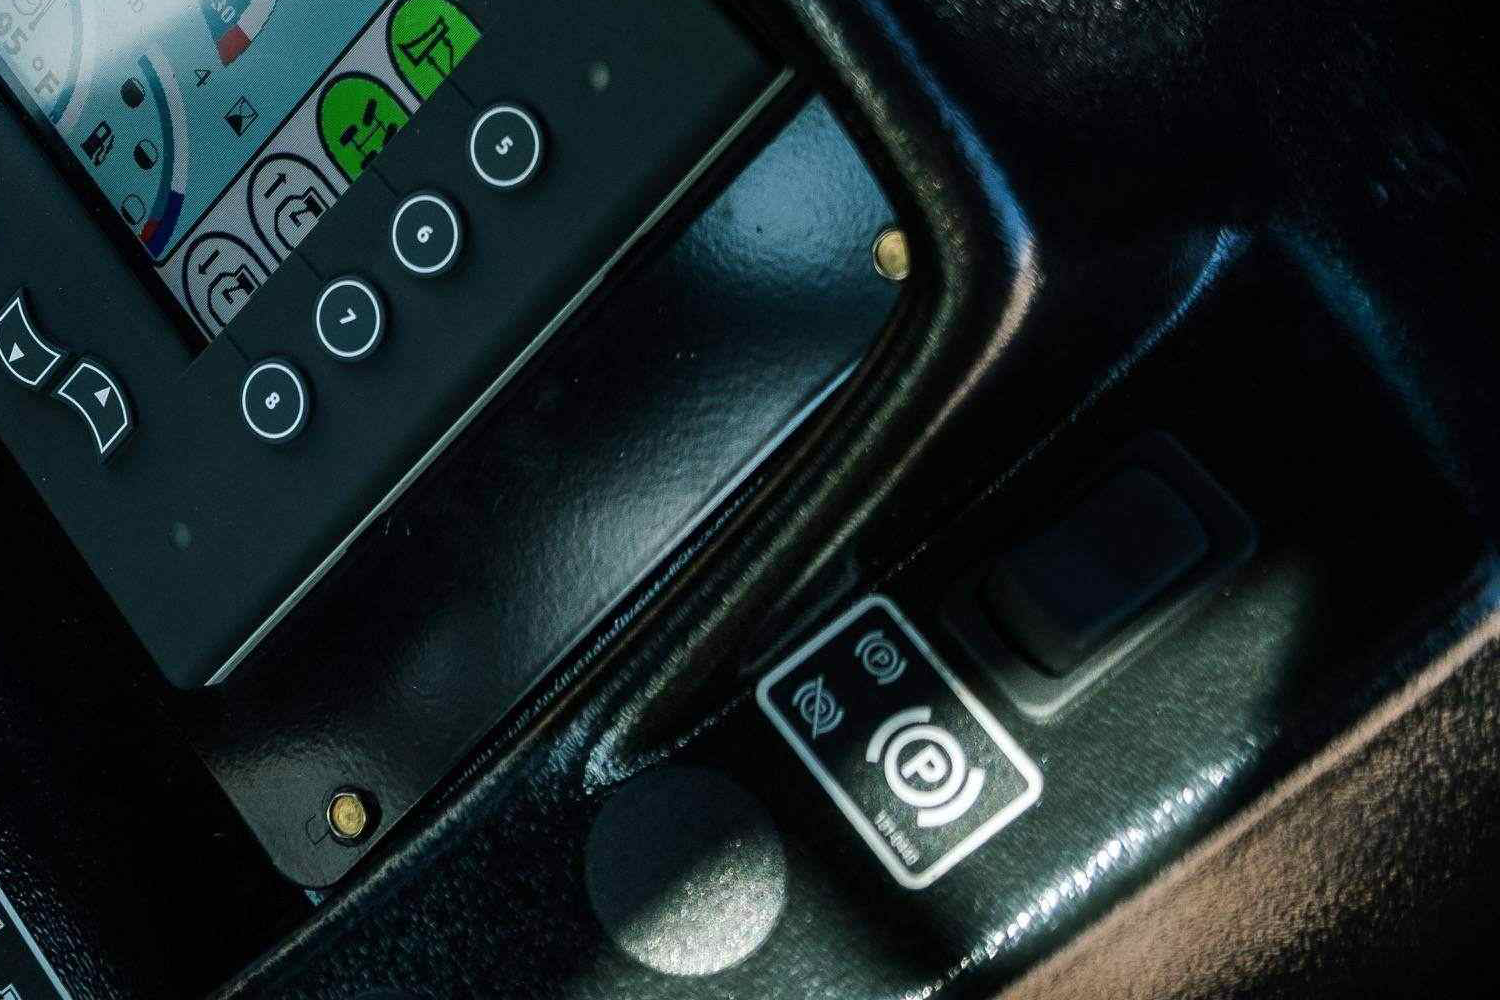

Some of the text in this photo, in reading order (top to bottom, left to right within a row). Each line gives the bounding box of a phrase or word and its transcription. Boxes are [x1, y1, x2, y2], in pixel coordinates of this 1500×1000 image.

[194, 68, 212, 88] 4
[495, 135, 514, 155] 5
[417, 225, 434, 243] 6
[339, 308, 357, 325] 7
[265, 392, 281, 410] 8
[901, 744, 949, 783] P
